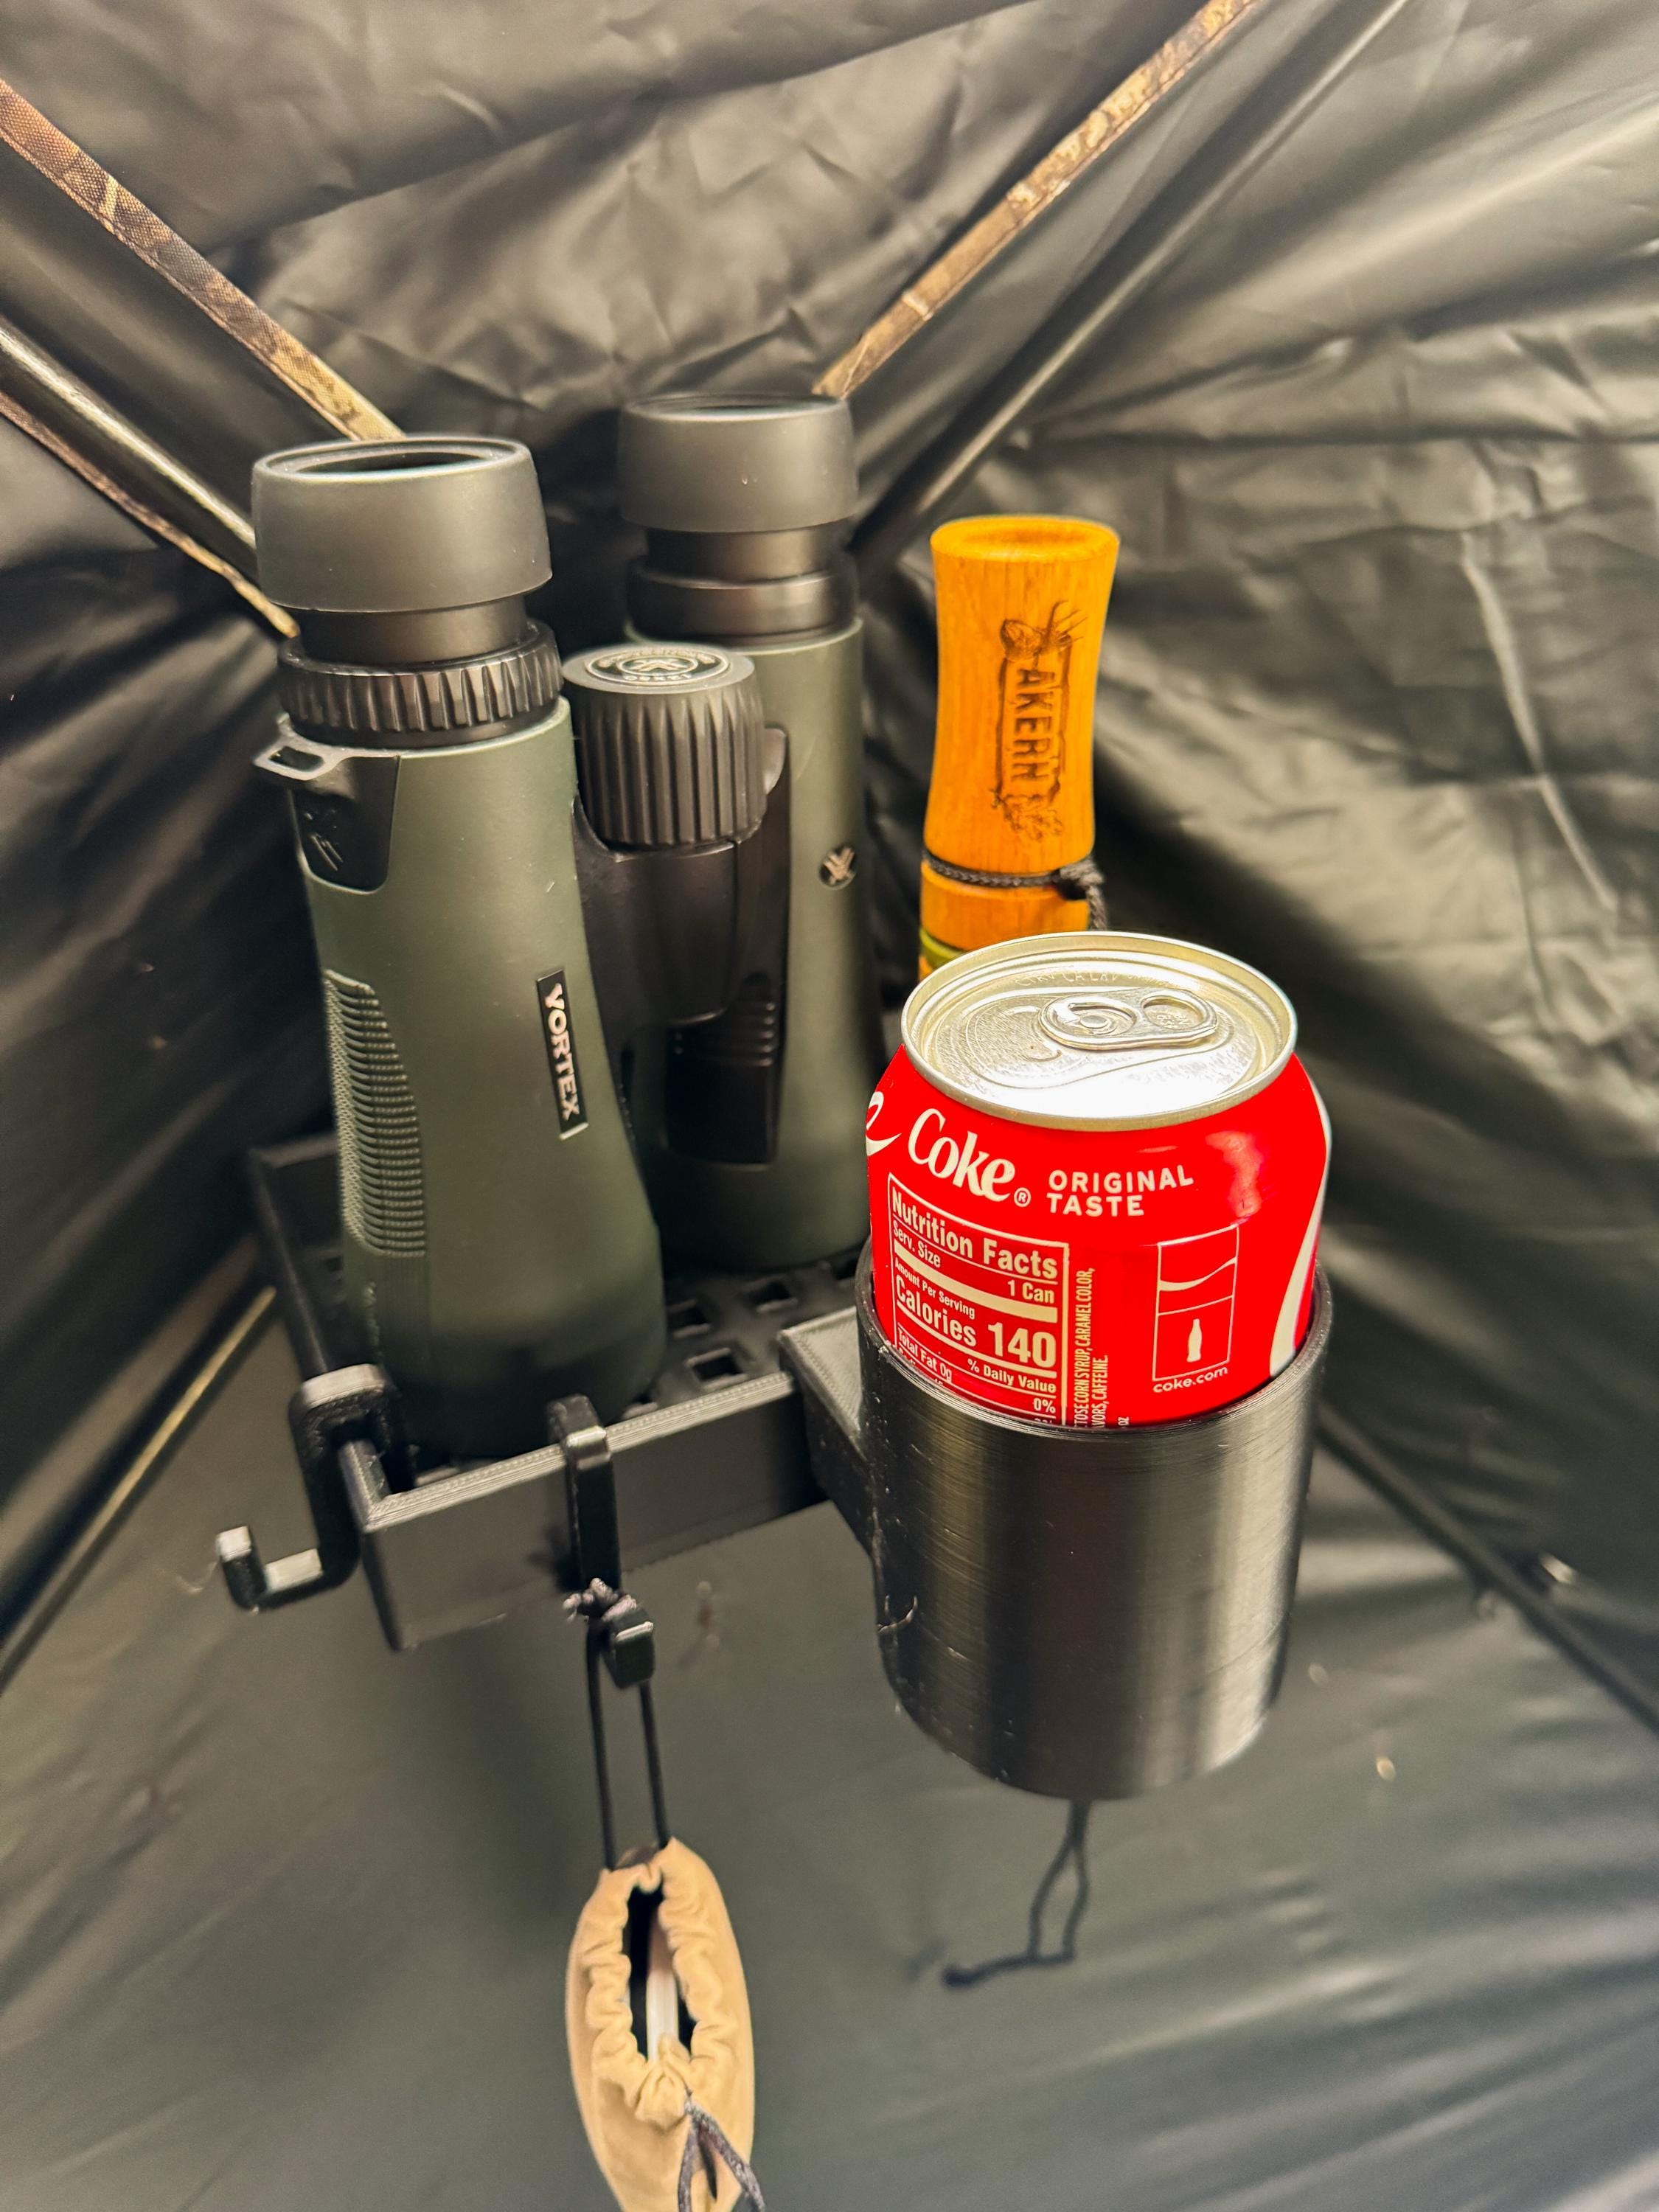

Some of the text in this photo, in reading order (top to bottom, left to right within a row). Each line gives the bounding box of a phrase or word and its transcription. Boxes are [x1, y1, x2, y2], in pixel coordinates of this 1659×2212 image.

[544, 982, 581, 1121] VORTEX
[1048, 1164, 1194, 1194] ORIGINAL
[1046, 1192, 1145, 1217] TASTE
[892, 1185, 1059, 1280] Nutrition Facts
[892, 1220, 1055, 1304] Serv. Size 1 Can
[1075, 1267, 1096, 1302] COLOR,
[894, 1256, 976, 1321] Amount Per Serving
[895, 1273, 977, 1347] Calories
[987, 1321, 1057, 1368] 140
[1074, 1302, 1091, 1347] CARAMEL
[897, 1326, 919, 1360] Total
[919, 1349, 938, 1371] Fat
[939, 1364, 953, 1384] 0g
[1033, 1397, 1057, 1415] 0%
[967, 1357, 1057, 1394] % Daily Value
[1074, 1348, 1093, 1379] SYRUP,
[1091, 1355, 1109, 1400] CAFFEINE.
[1152, 1365, 1229, 1394] coke.com
[1074, 1378, 1090, 1403] CORN
